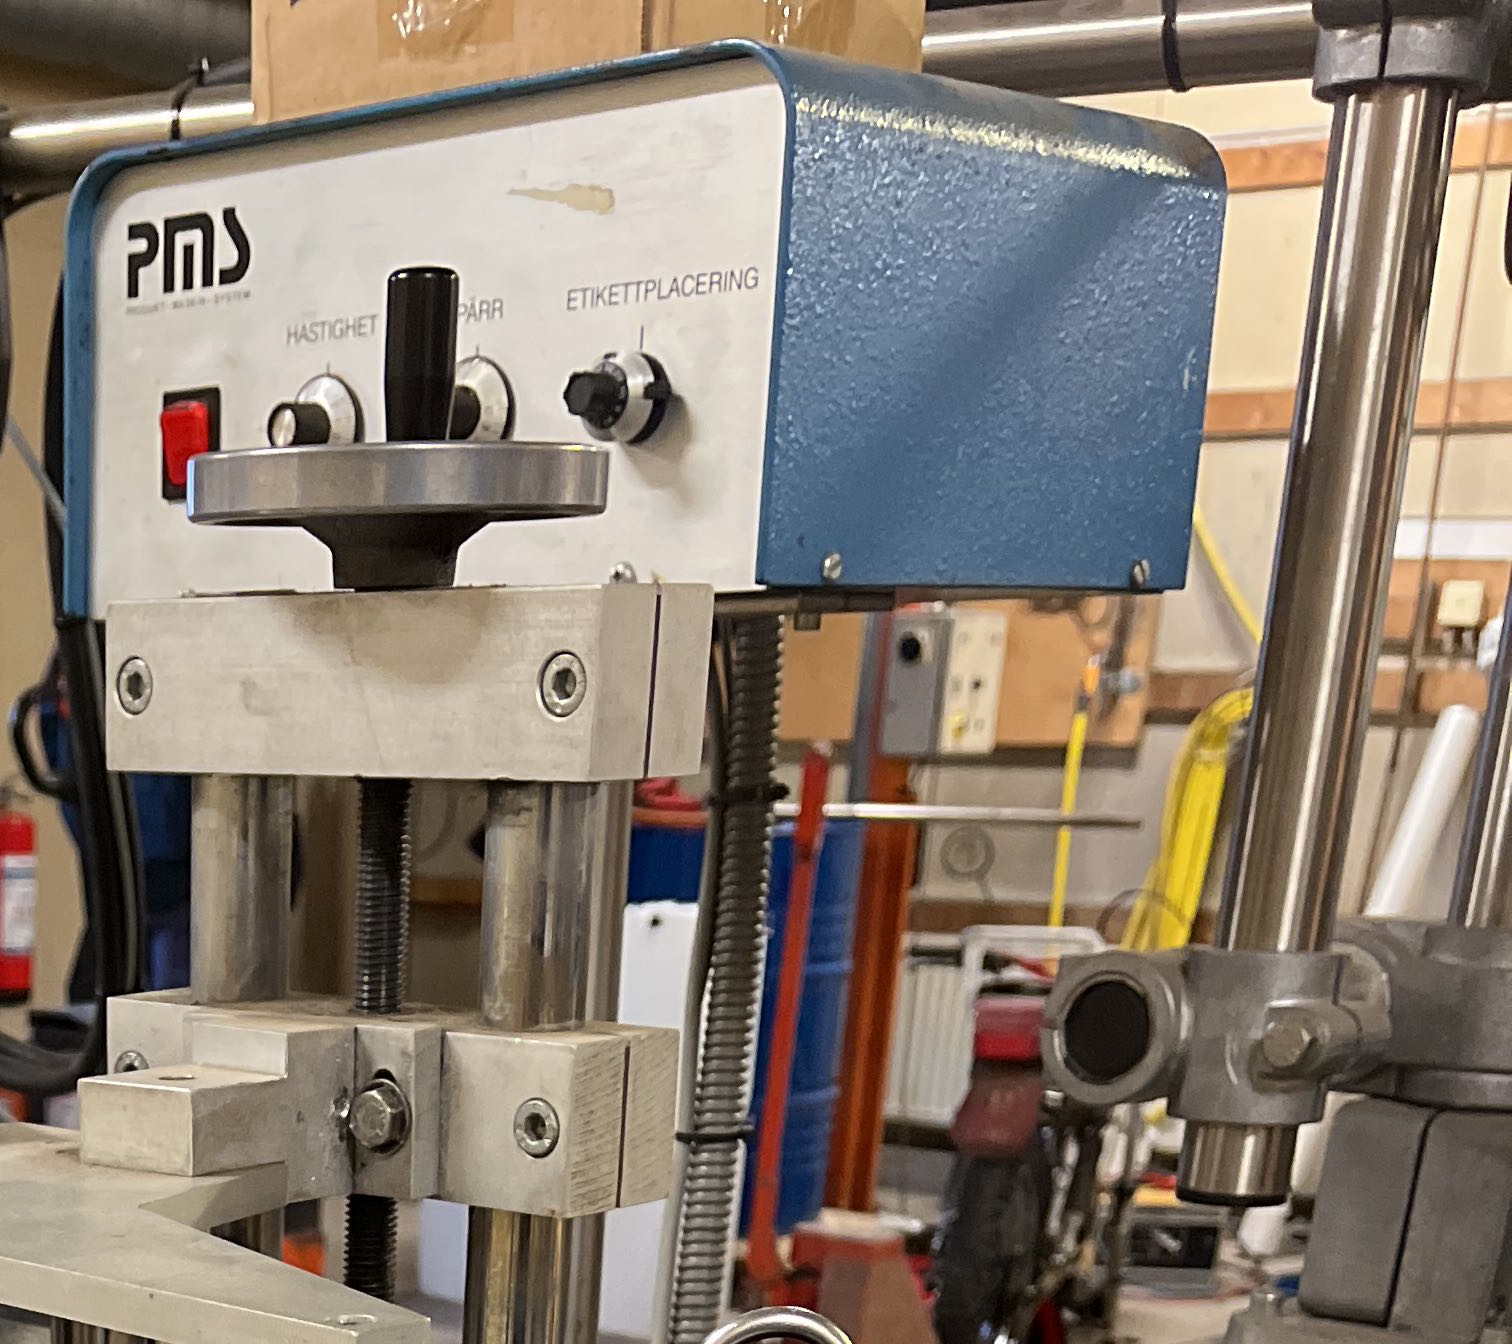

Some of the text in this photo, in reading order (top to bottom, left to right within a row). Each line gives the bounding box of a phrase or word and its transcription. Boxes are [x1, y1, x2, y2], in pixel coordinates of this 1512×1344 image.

[127, 206, 251, 299] PMS
[566, 266, 760, 312] ETIKETTPLACERING
[286, 313, 380, 345] HASTIGHET
[457, 295, 504, 325] PÄRR
